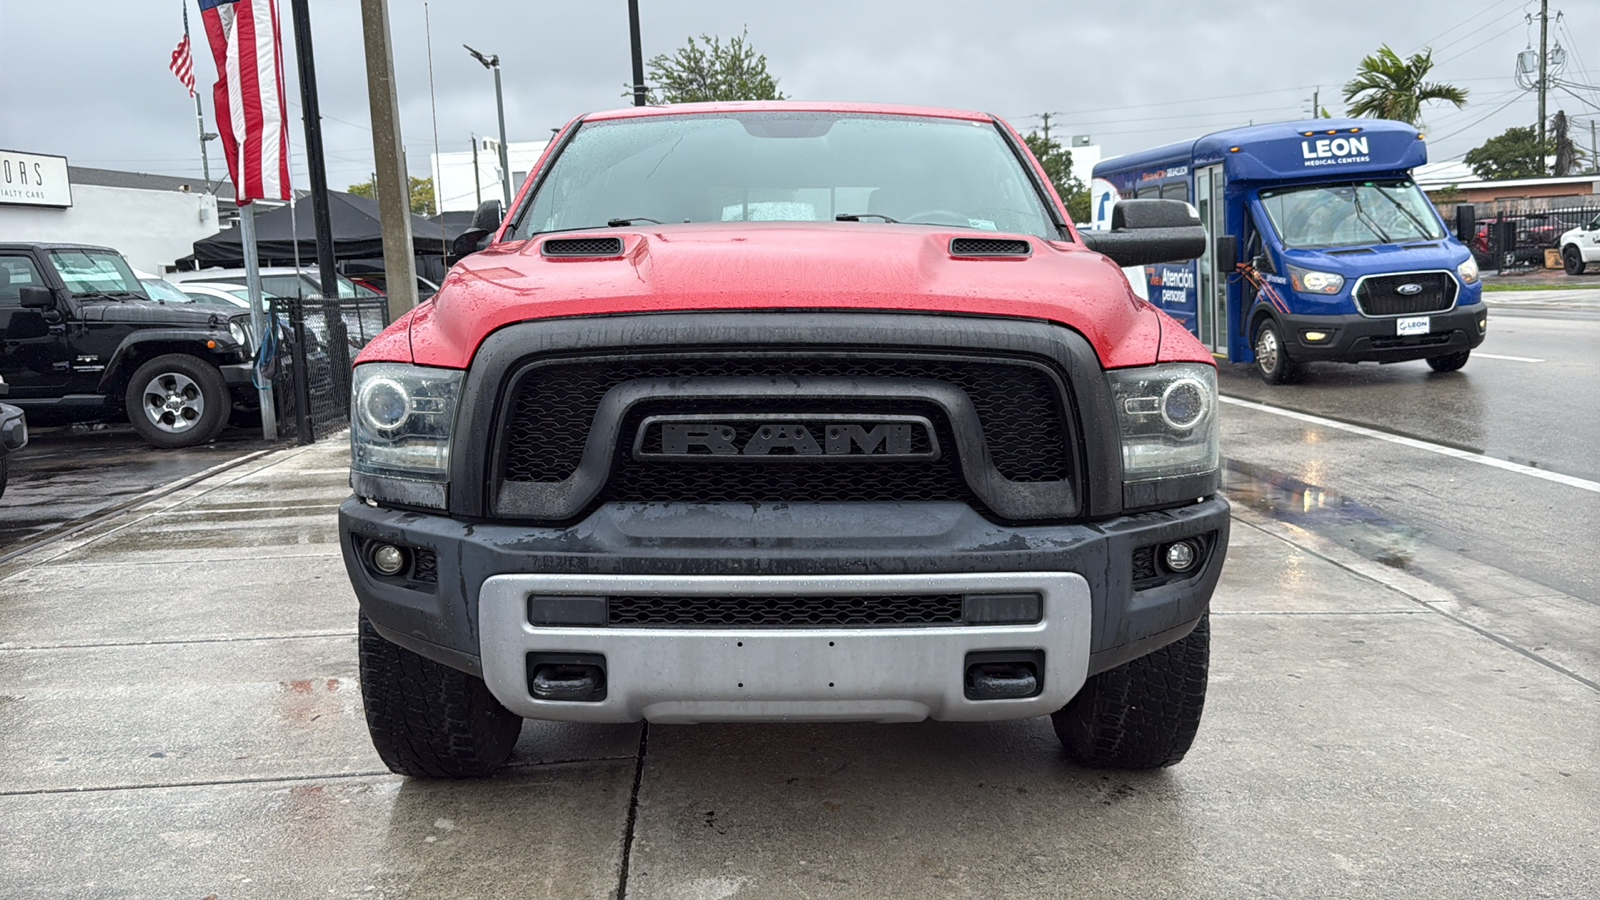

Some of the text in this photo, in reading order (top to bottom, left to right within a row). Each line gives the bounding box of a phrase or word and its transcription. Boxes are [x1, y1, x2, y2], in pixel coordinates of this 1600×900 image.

[1301, 136, 1369, 159] LEON
[1304, 155, 1370, 167] MEDICAL CENTERS
[25, 190, 45, 199] CARS
[1162, 267, 1194, 288] Atención
[1162, 288, 1186, 304] personal
[662, 424, 912, 454] RAM
